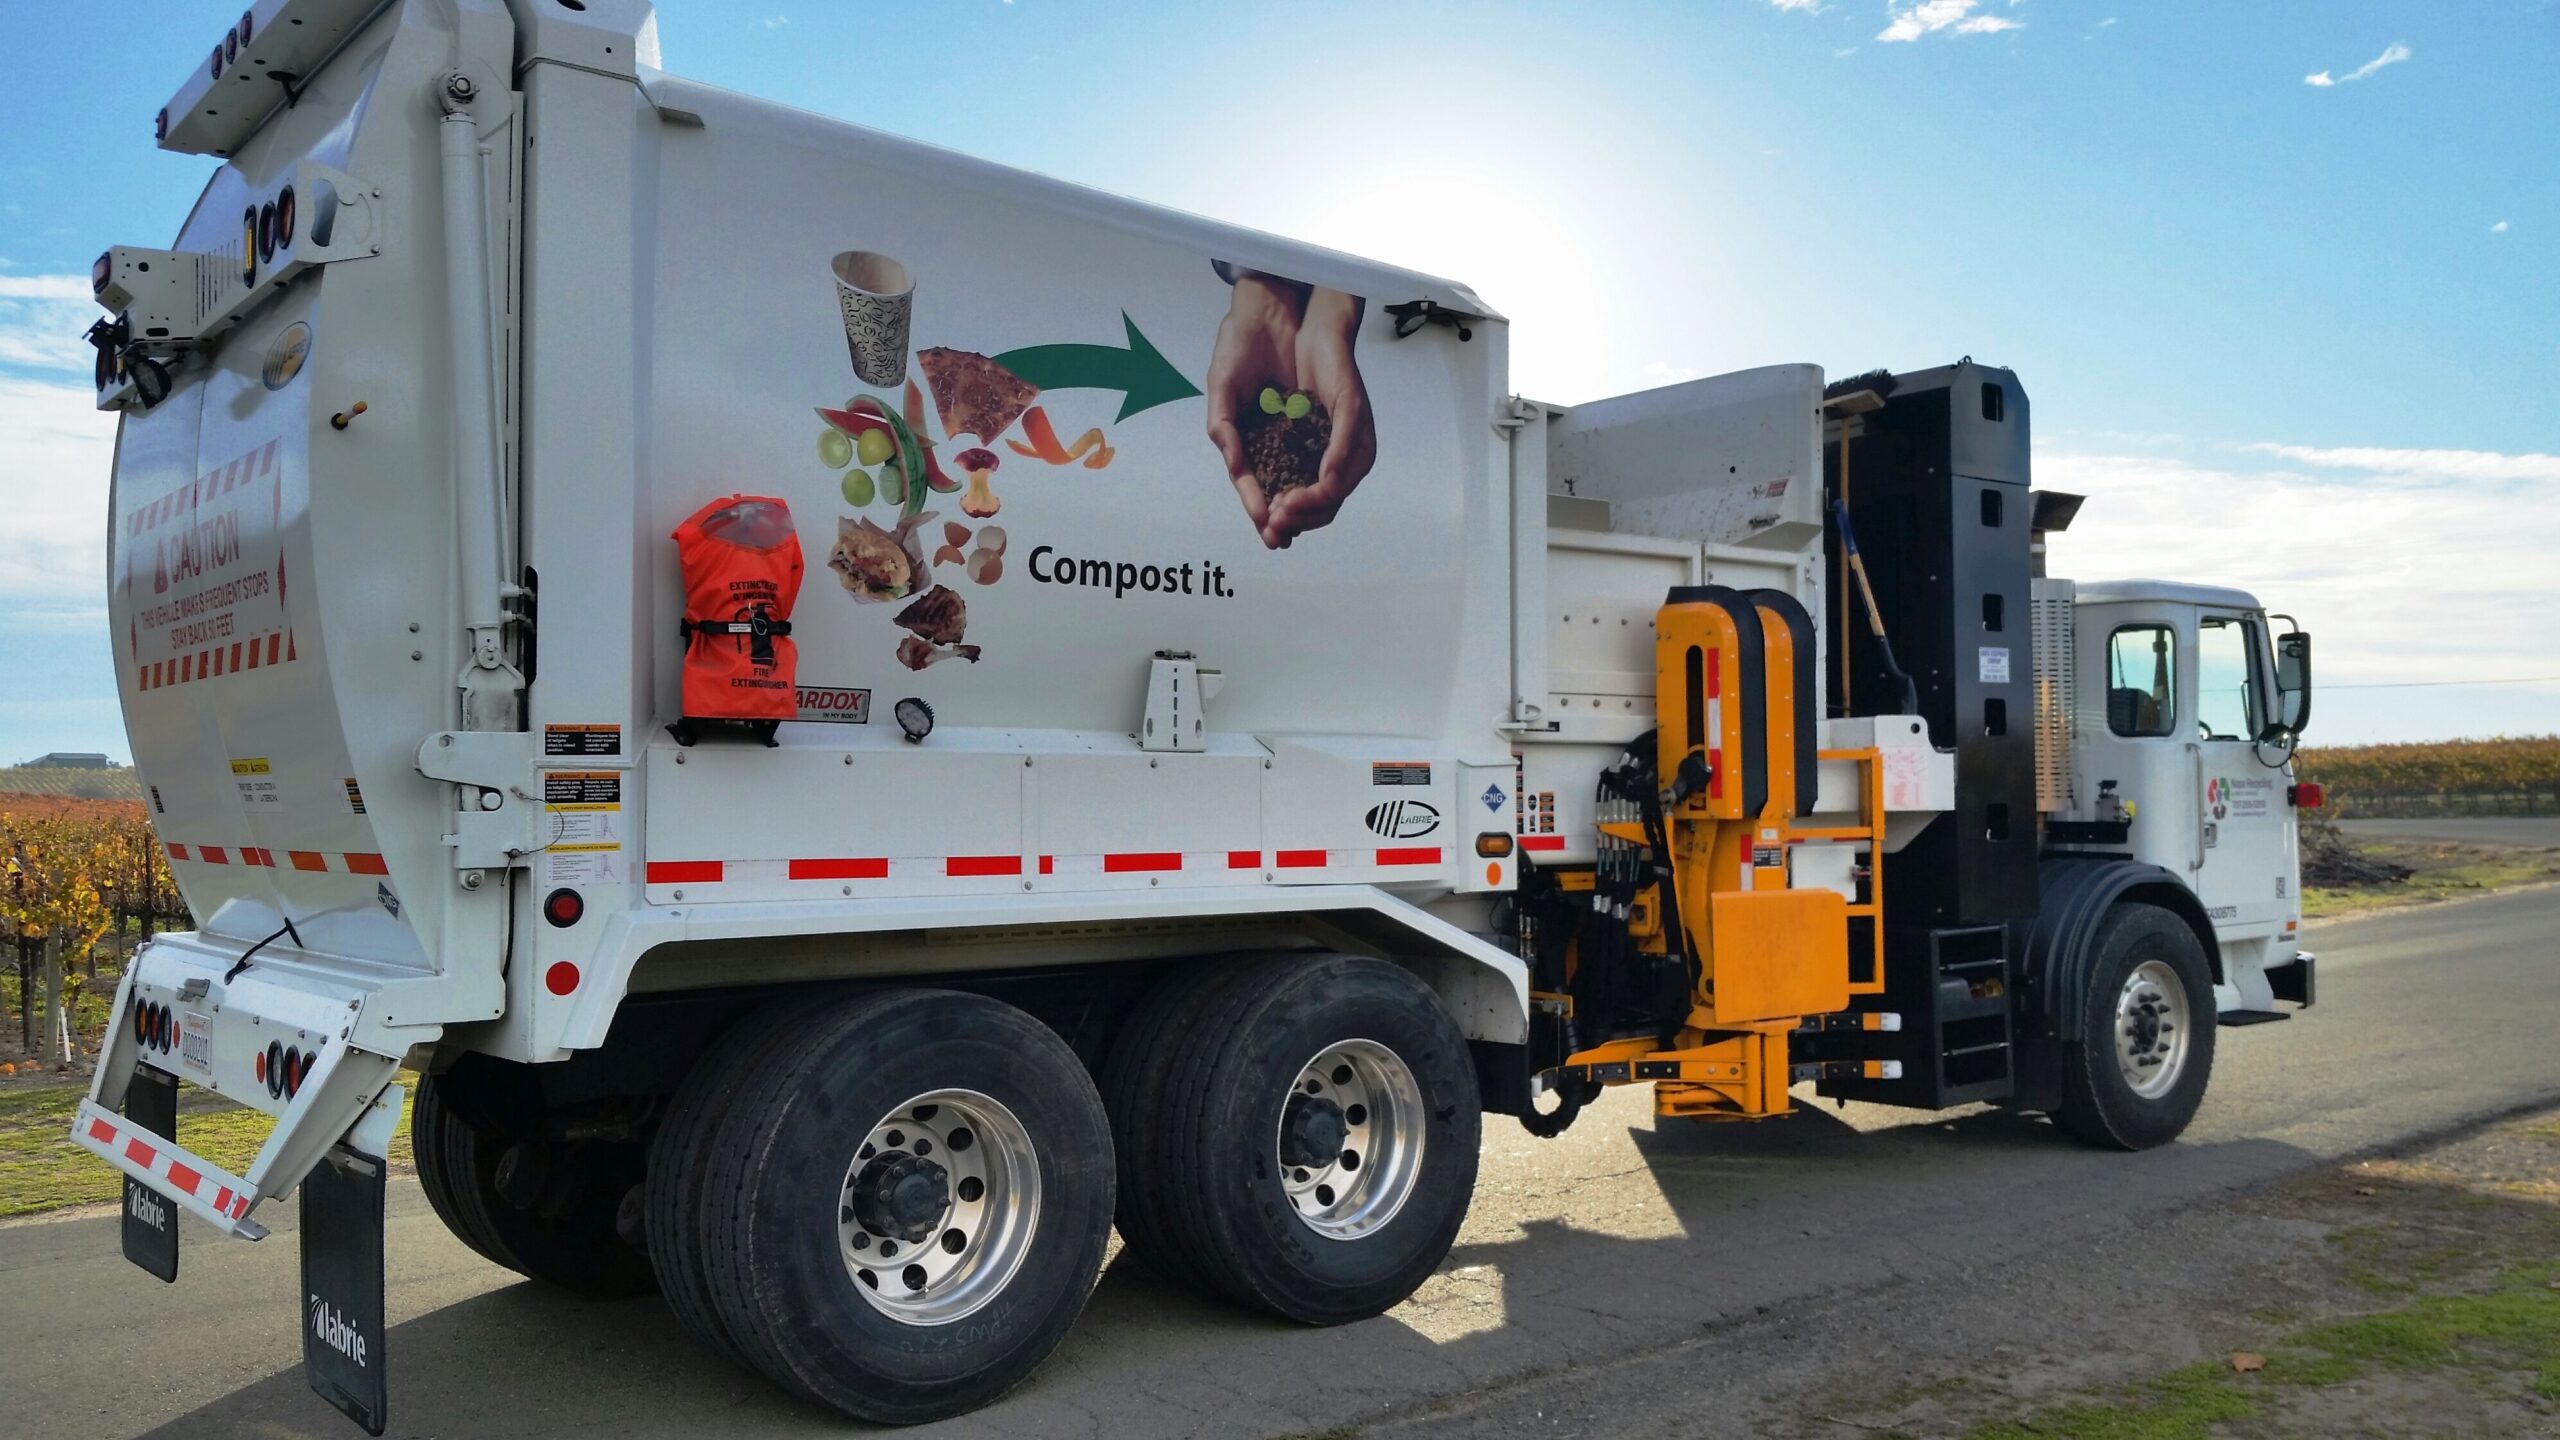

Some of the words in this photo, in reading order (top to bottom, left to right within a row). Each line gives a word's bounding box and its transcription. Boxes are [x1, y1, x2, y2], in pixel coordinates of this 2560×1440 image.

[170, 509, 239, 583] CAUTION
[1028, 545, 1193, 599] Compost
[1203, 560, 1234, 598] it.
[181, 592, 205, 619] MAKES
[205, 580, 241, 611] FREQUENT
[243, 571, 269, 600] STOPS
[171, 627, 187, 649] STAY
[188, 621, 208, 645] BACK
[216, 613, 234, 637] FEET
[753, 668, 770, 678] FIRE
[795, 690, 863, 710] ARDOX
[1483, 793, 1503, 803] CNG
[1400, 815, 1432, 824] LABRIE
[137, 1186, 165, 1232] labrie
[324, 1301, 366, 1368] labrie
